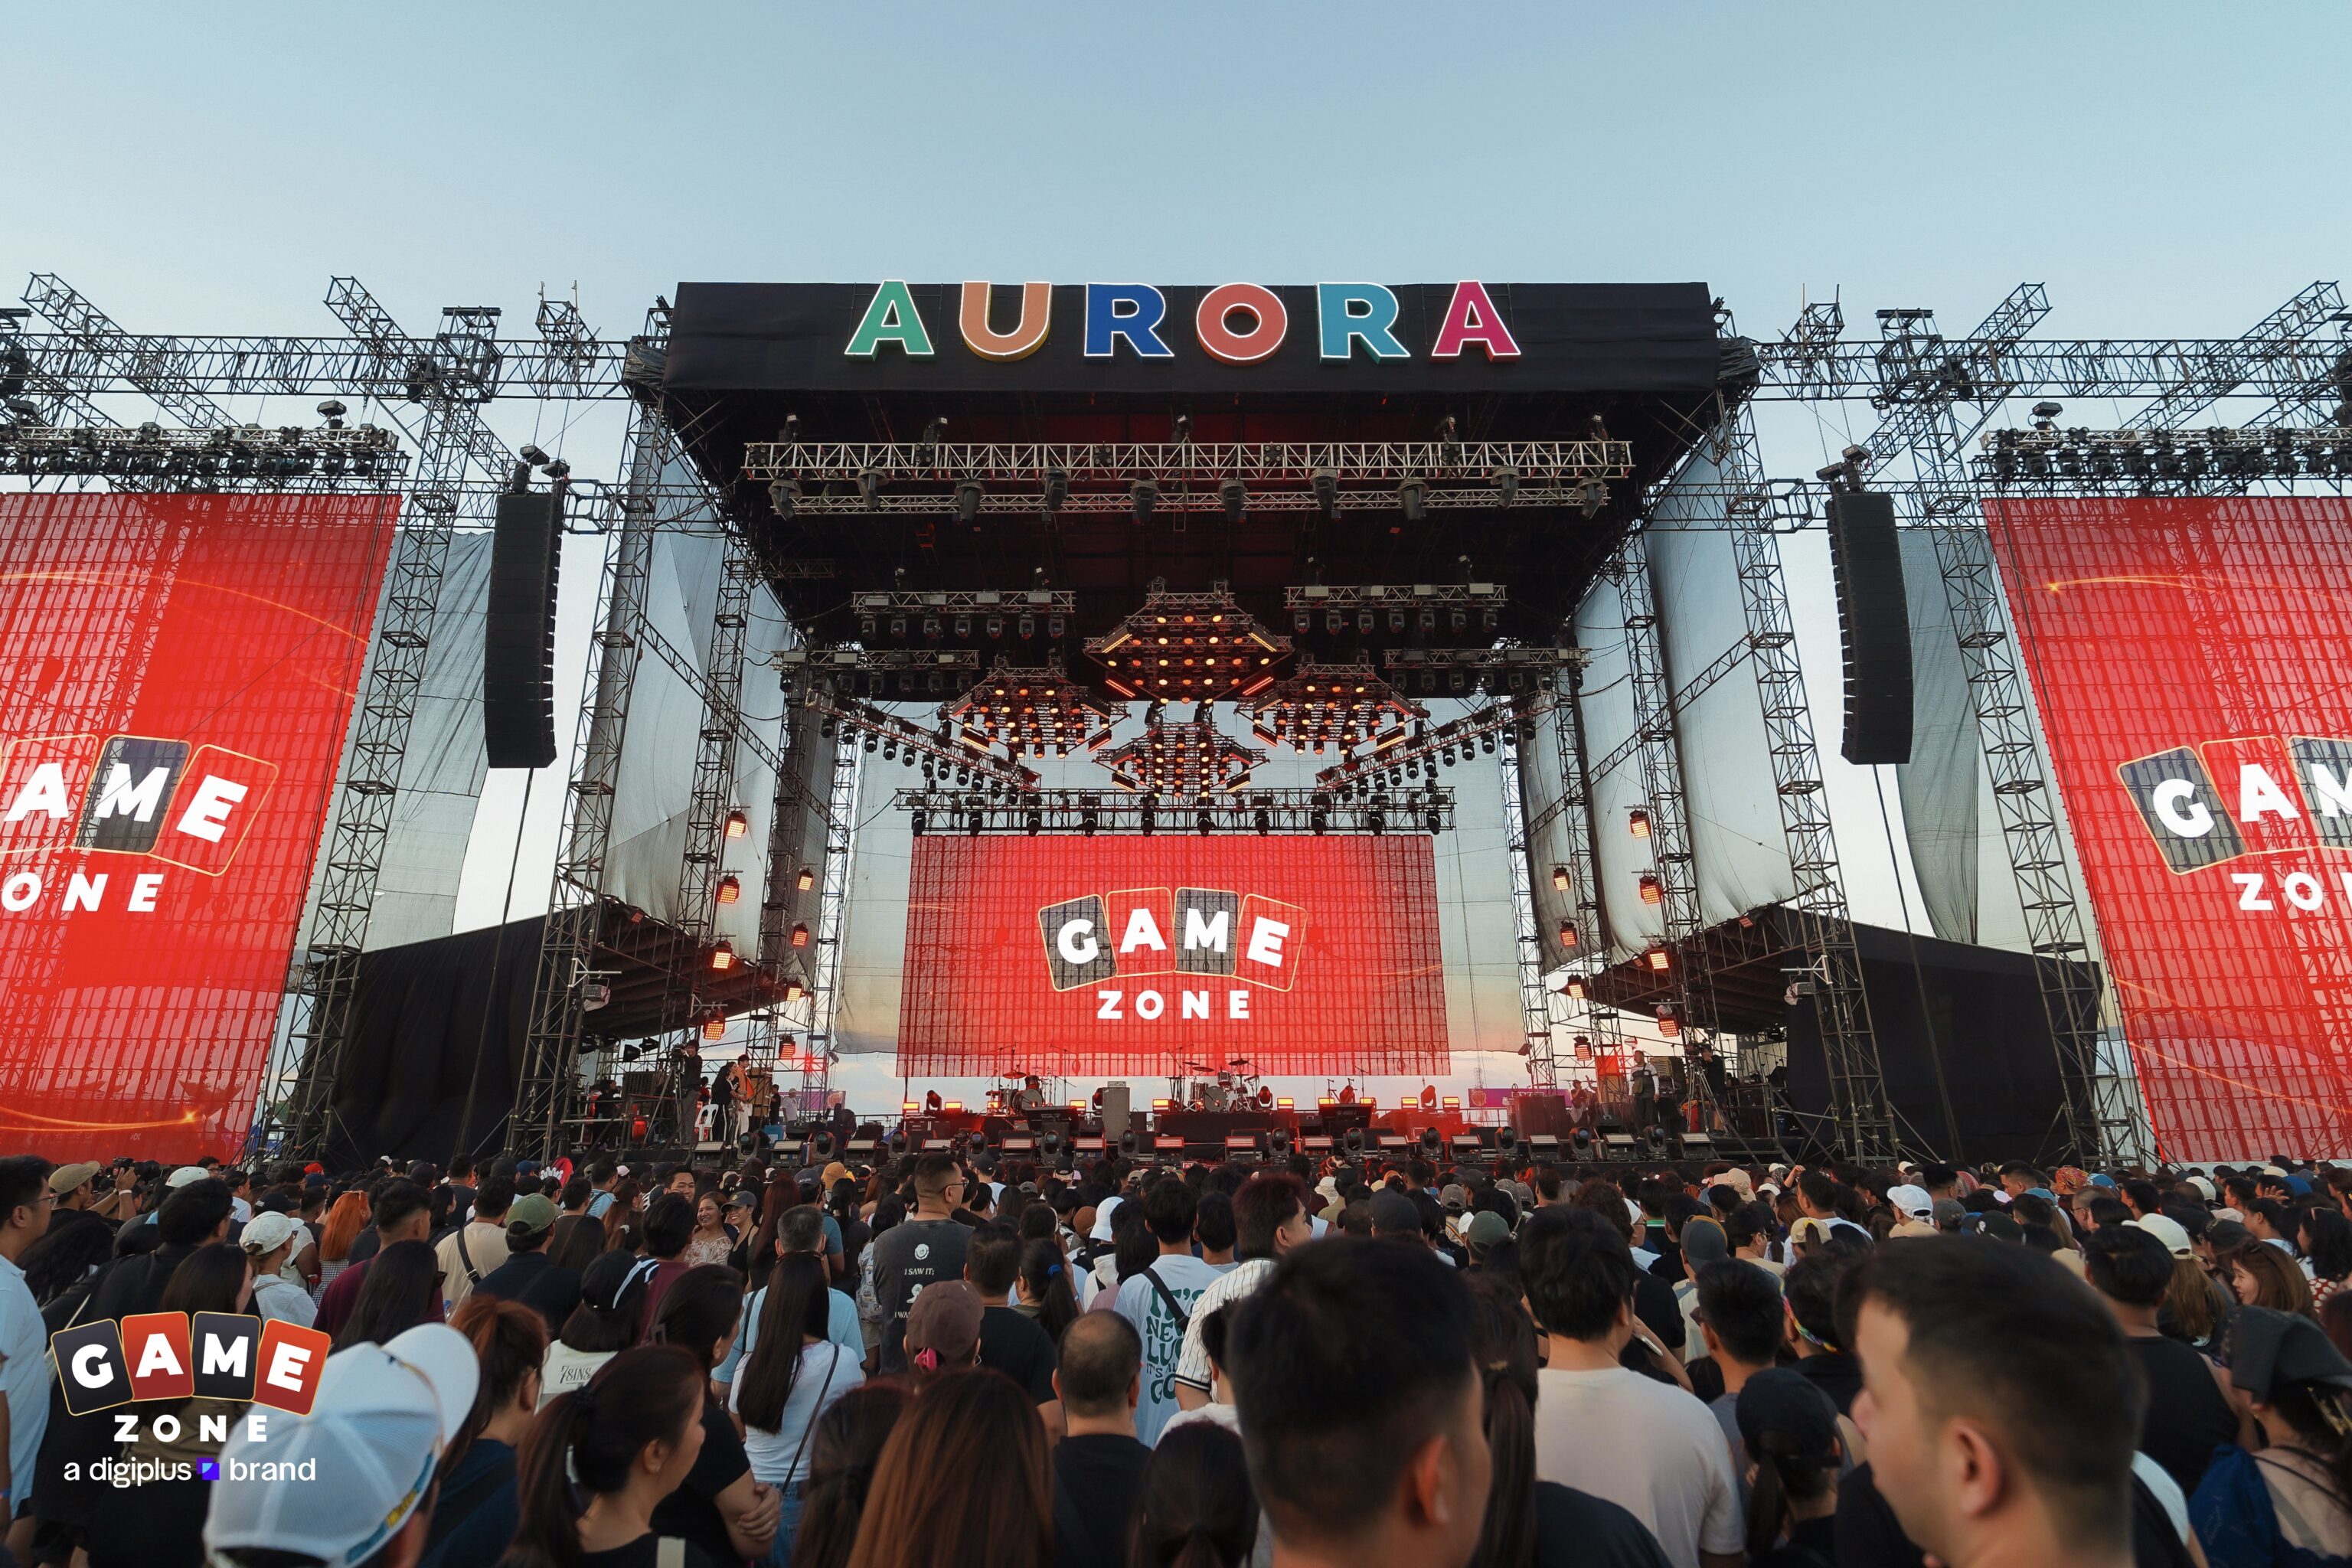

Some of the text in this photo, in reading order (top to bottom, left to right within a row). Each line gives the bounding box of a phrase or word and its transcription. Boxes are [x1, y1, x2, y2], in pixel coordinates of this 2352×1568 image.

[844, 279, 1522, 363] AURORA
[3, 763, 248, 843] AME
[2153, 763, 2352, 838] GAM
[1, 871, 164, 912] ONE
[2231, 871, 2352, 911] ZO
[1057, 907, 1290, 968] GAME
[1097, 990, 1250, 1020] ZONE
